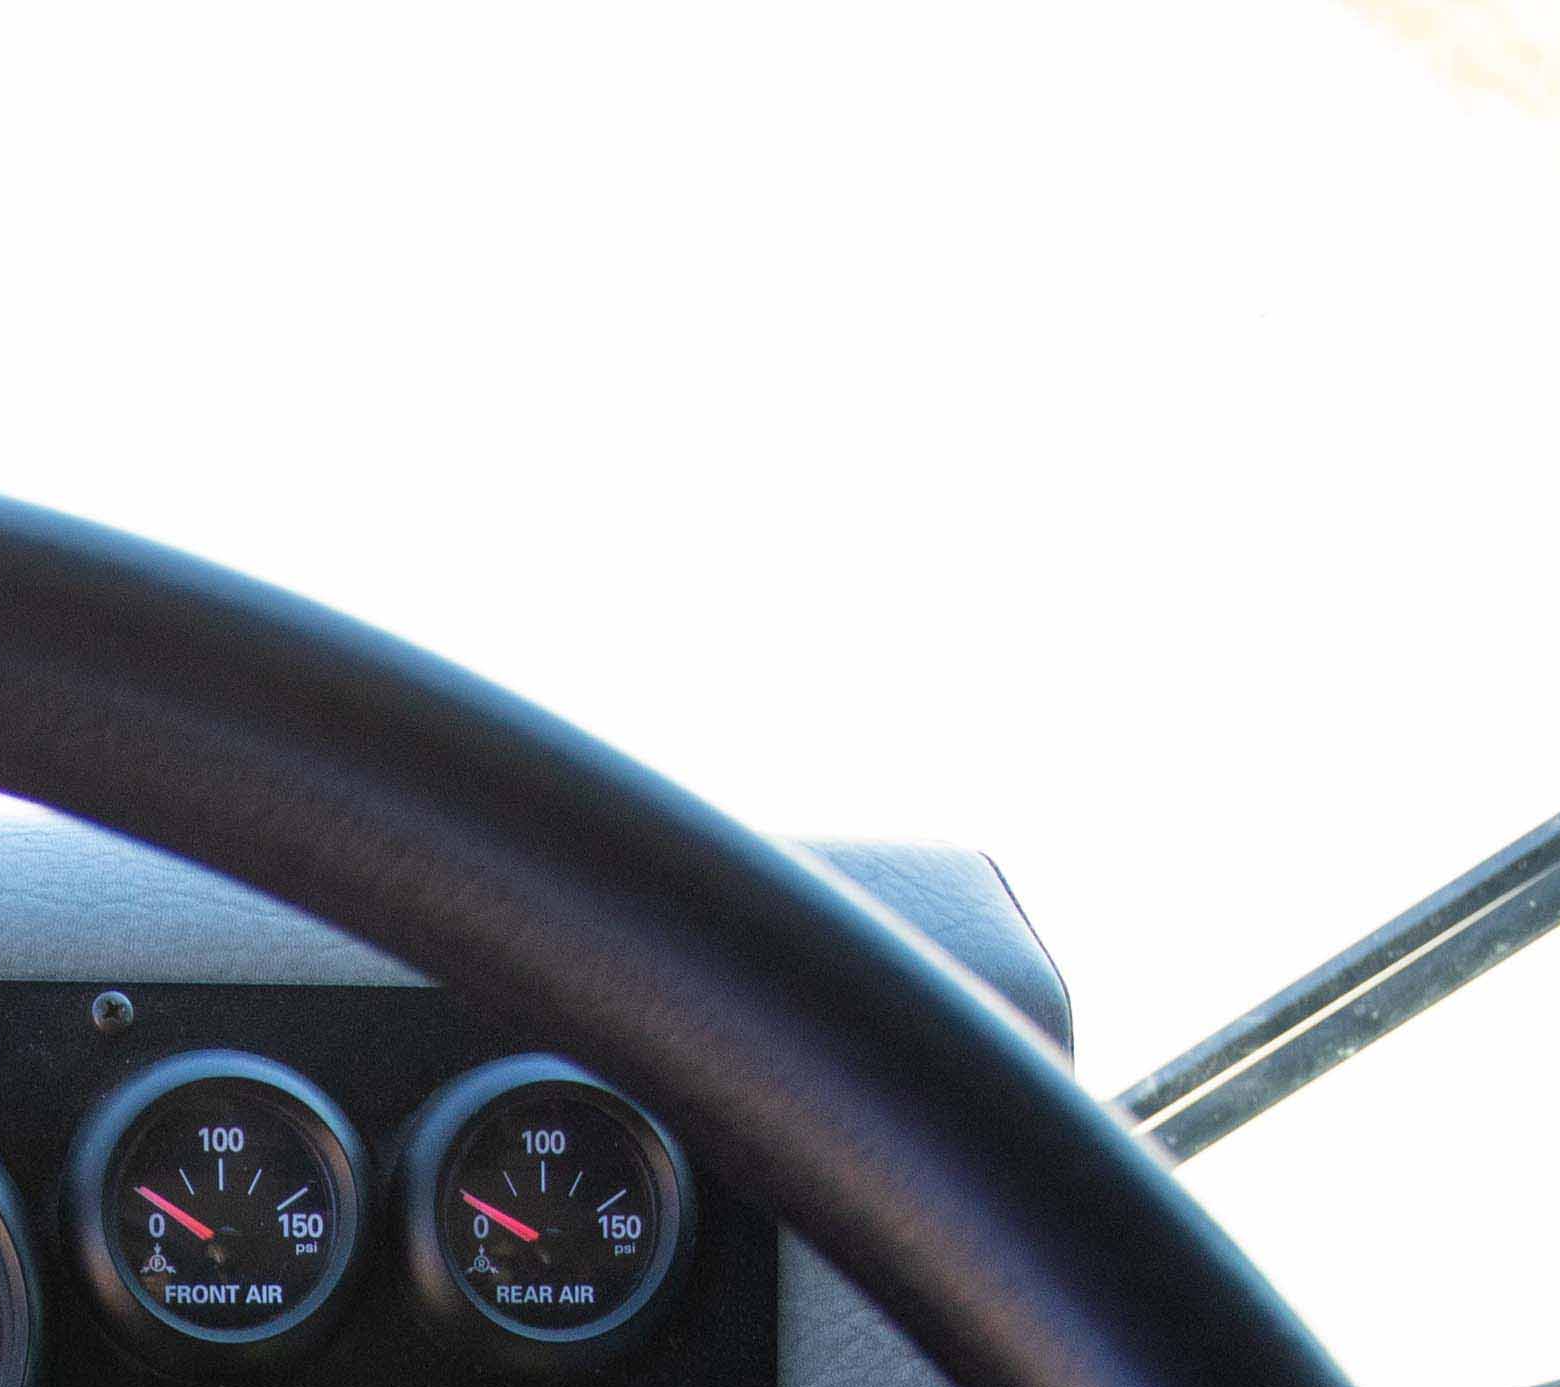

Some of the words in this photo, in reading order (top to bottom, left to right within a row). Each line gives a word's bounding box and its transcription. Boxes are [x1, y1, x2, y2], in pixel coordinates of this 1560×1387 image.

[198, 1127, 243, 1152] 100
[522, 1130, 565, 1154] 100
[148, 1213, 165, 1238] 0
[278, 1214, 324, 1239] 150
[473, 1214, 489, 1239] 0
[597, 1215, 641, 1240] 150
[294, 1241, 318, 1255] psi
[613, 1242, 636, 1256] psi
[164, 1285, 240, 1304] FRONT
[245, 1284, 283, 1303] AIR
[496, 1285, 553, 1304] REAR
[557, 1285, 594, 1303] AIR
